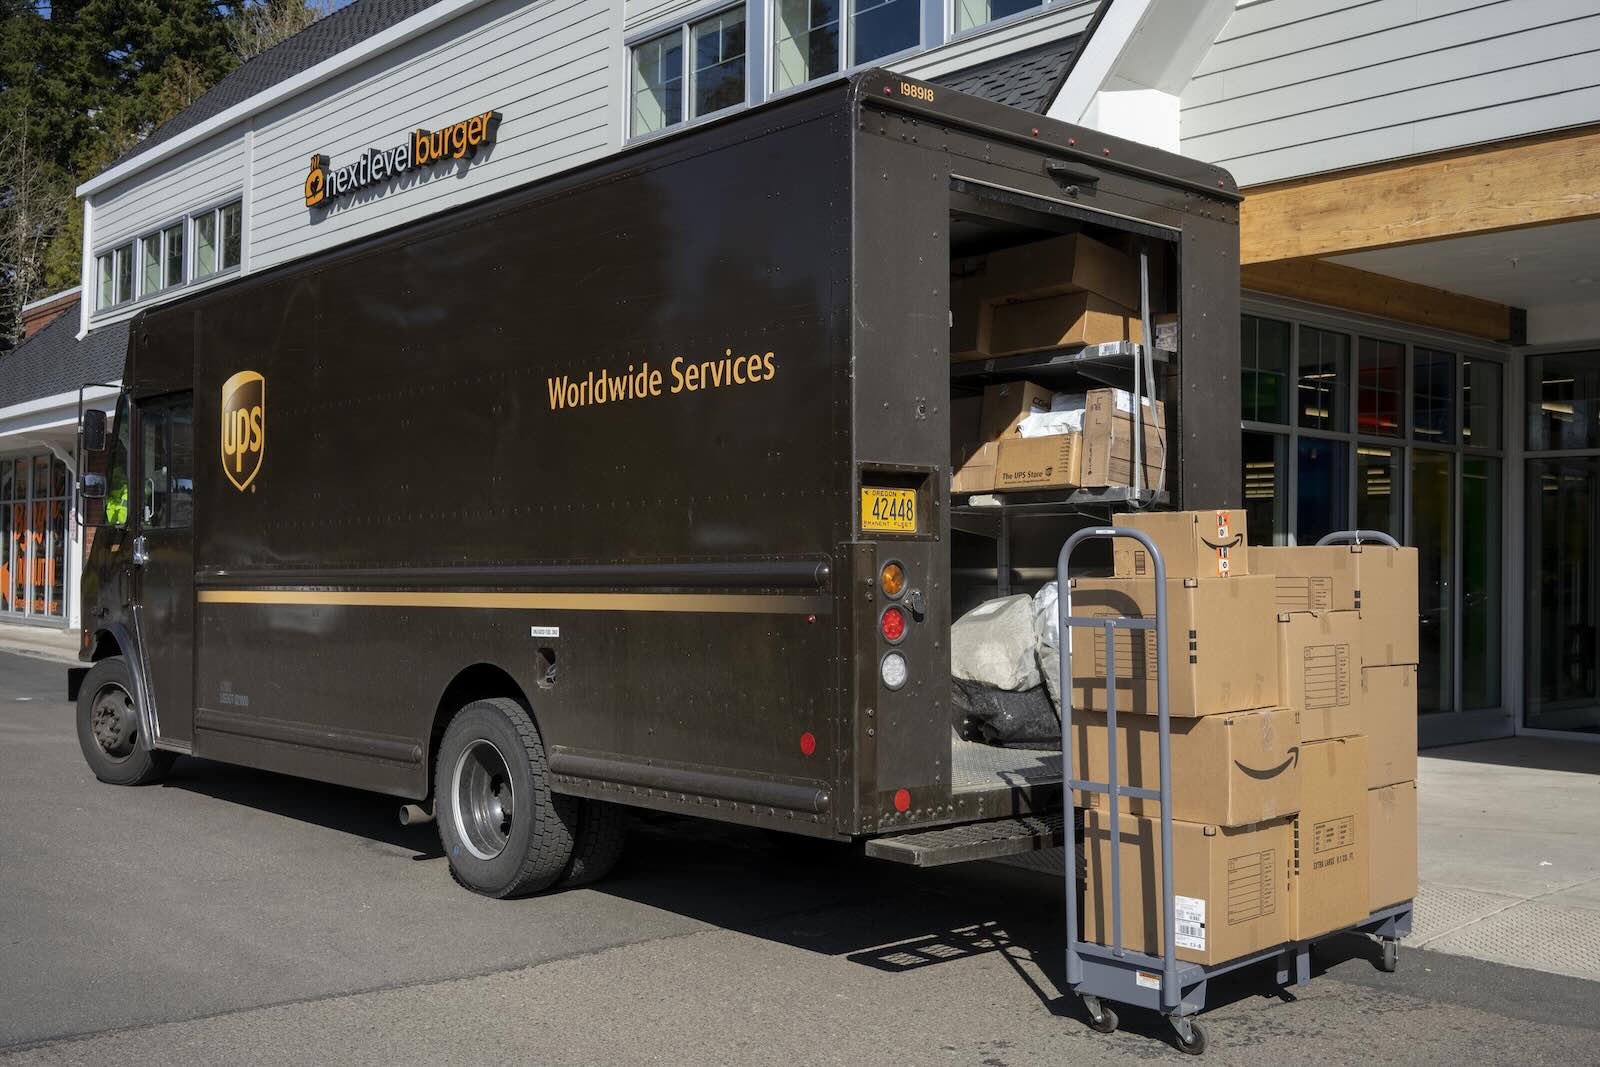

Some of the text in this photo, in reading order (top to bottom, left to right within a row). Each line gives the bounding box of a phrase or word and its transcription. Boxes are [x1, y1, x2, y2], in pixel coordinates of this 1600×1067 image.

[901, 81, 934, 102] 198918
[548, 348, 776, 410] Worldwide Services
[1002, 470, 1043, 480] The UPS Store
[872, 497, 913, 521] 42448
